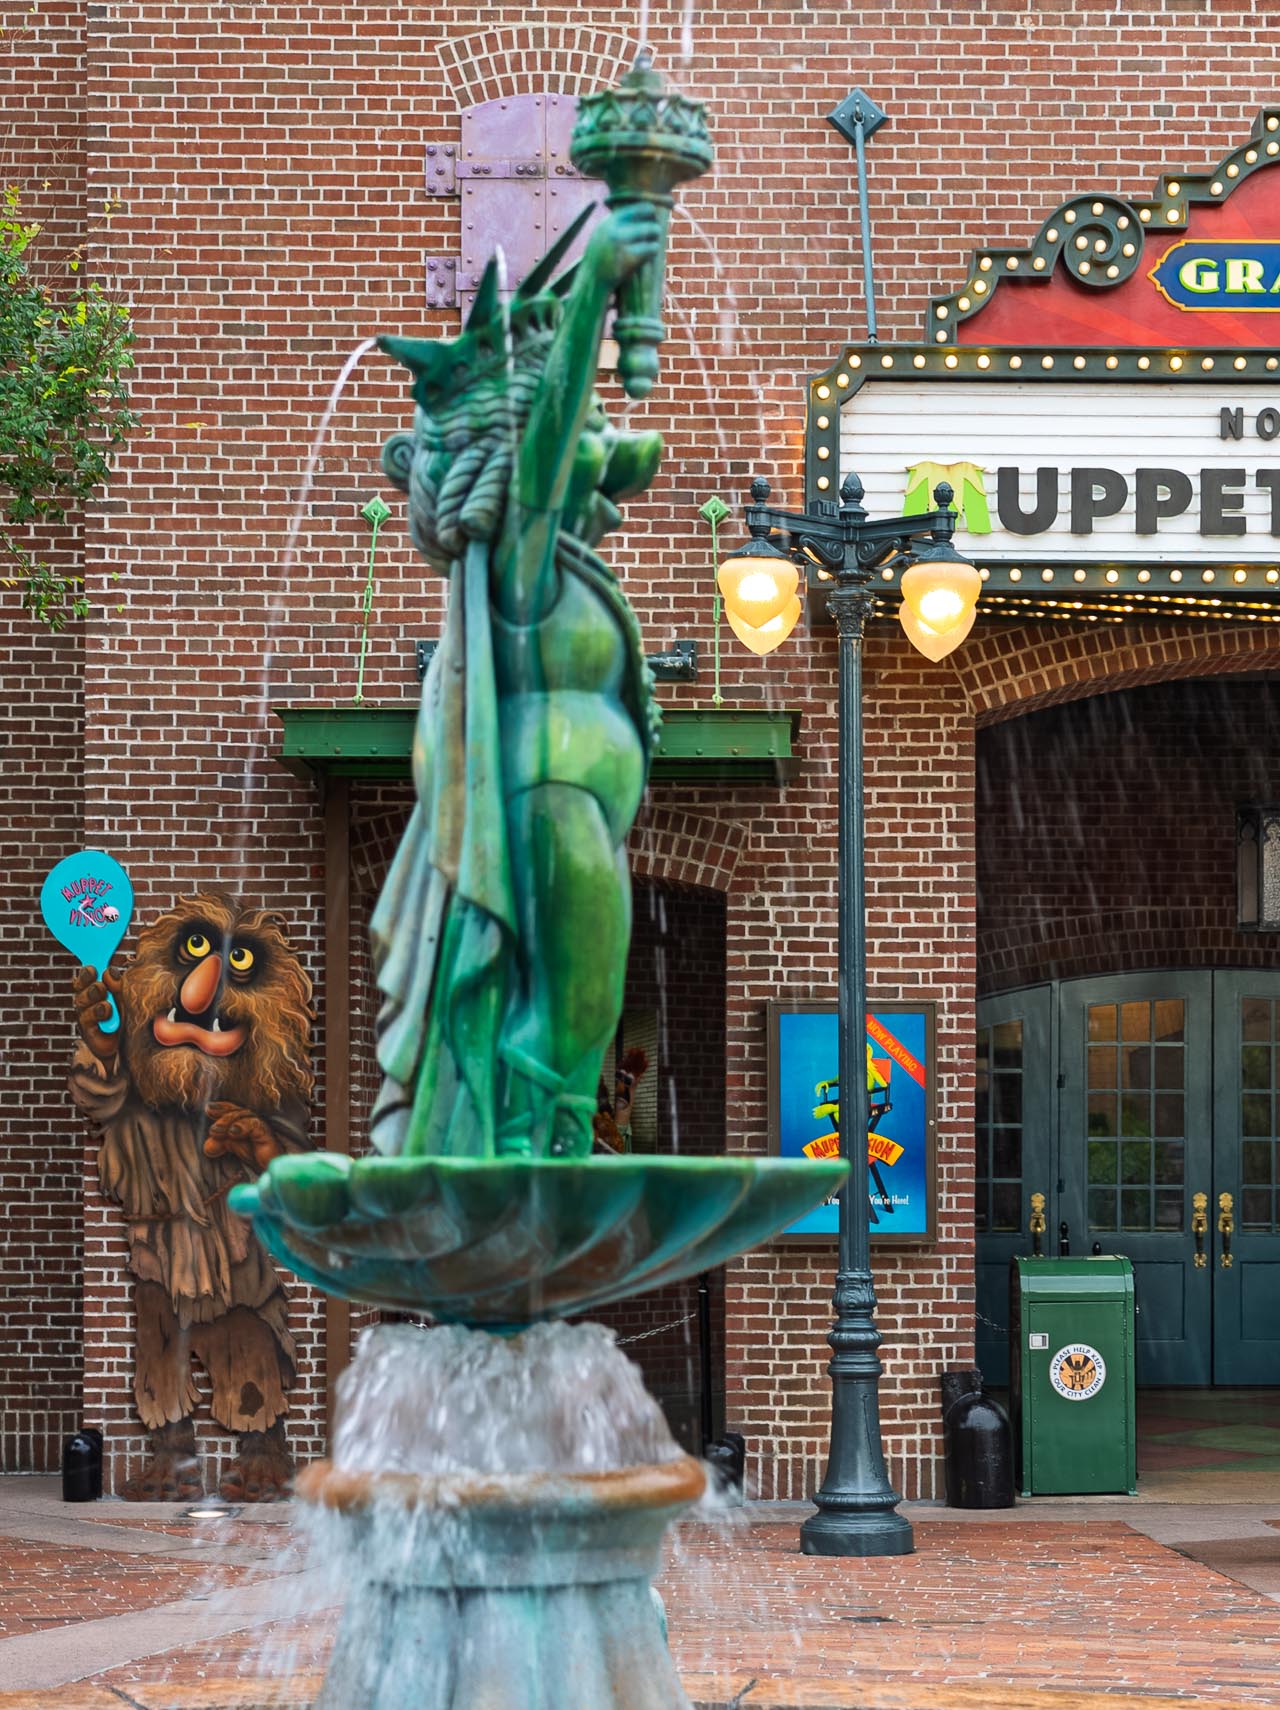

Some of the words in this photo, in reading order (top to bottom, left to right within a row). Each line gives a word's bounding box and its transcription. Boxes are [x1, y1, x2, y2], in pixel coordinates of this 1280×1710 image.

[61, 877, 113, 903] MUPPET
[866, 1020, 887, 1040] NOW
[884, 1038, 918, 1072] PLAYING
[1053, 1349, 1070, 1370] PLEASE
[1091, 1353, 1103, 1370] KEEP
[1054, 1378, 1066, 1393] OUR
[1084, 1377, 1102, 1396] CLEAN
